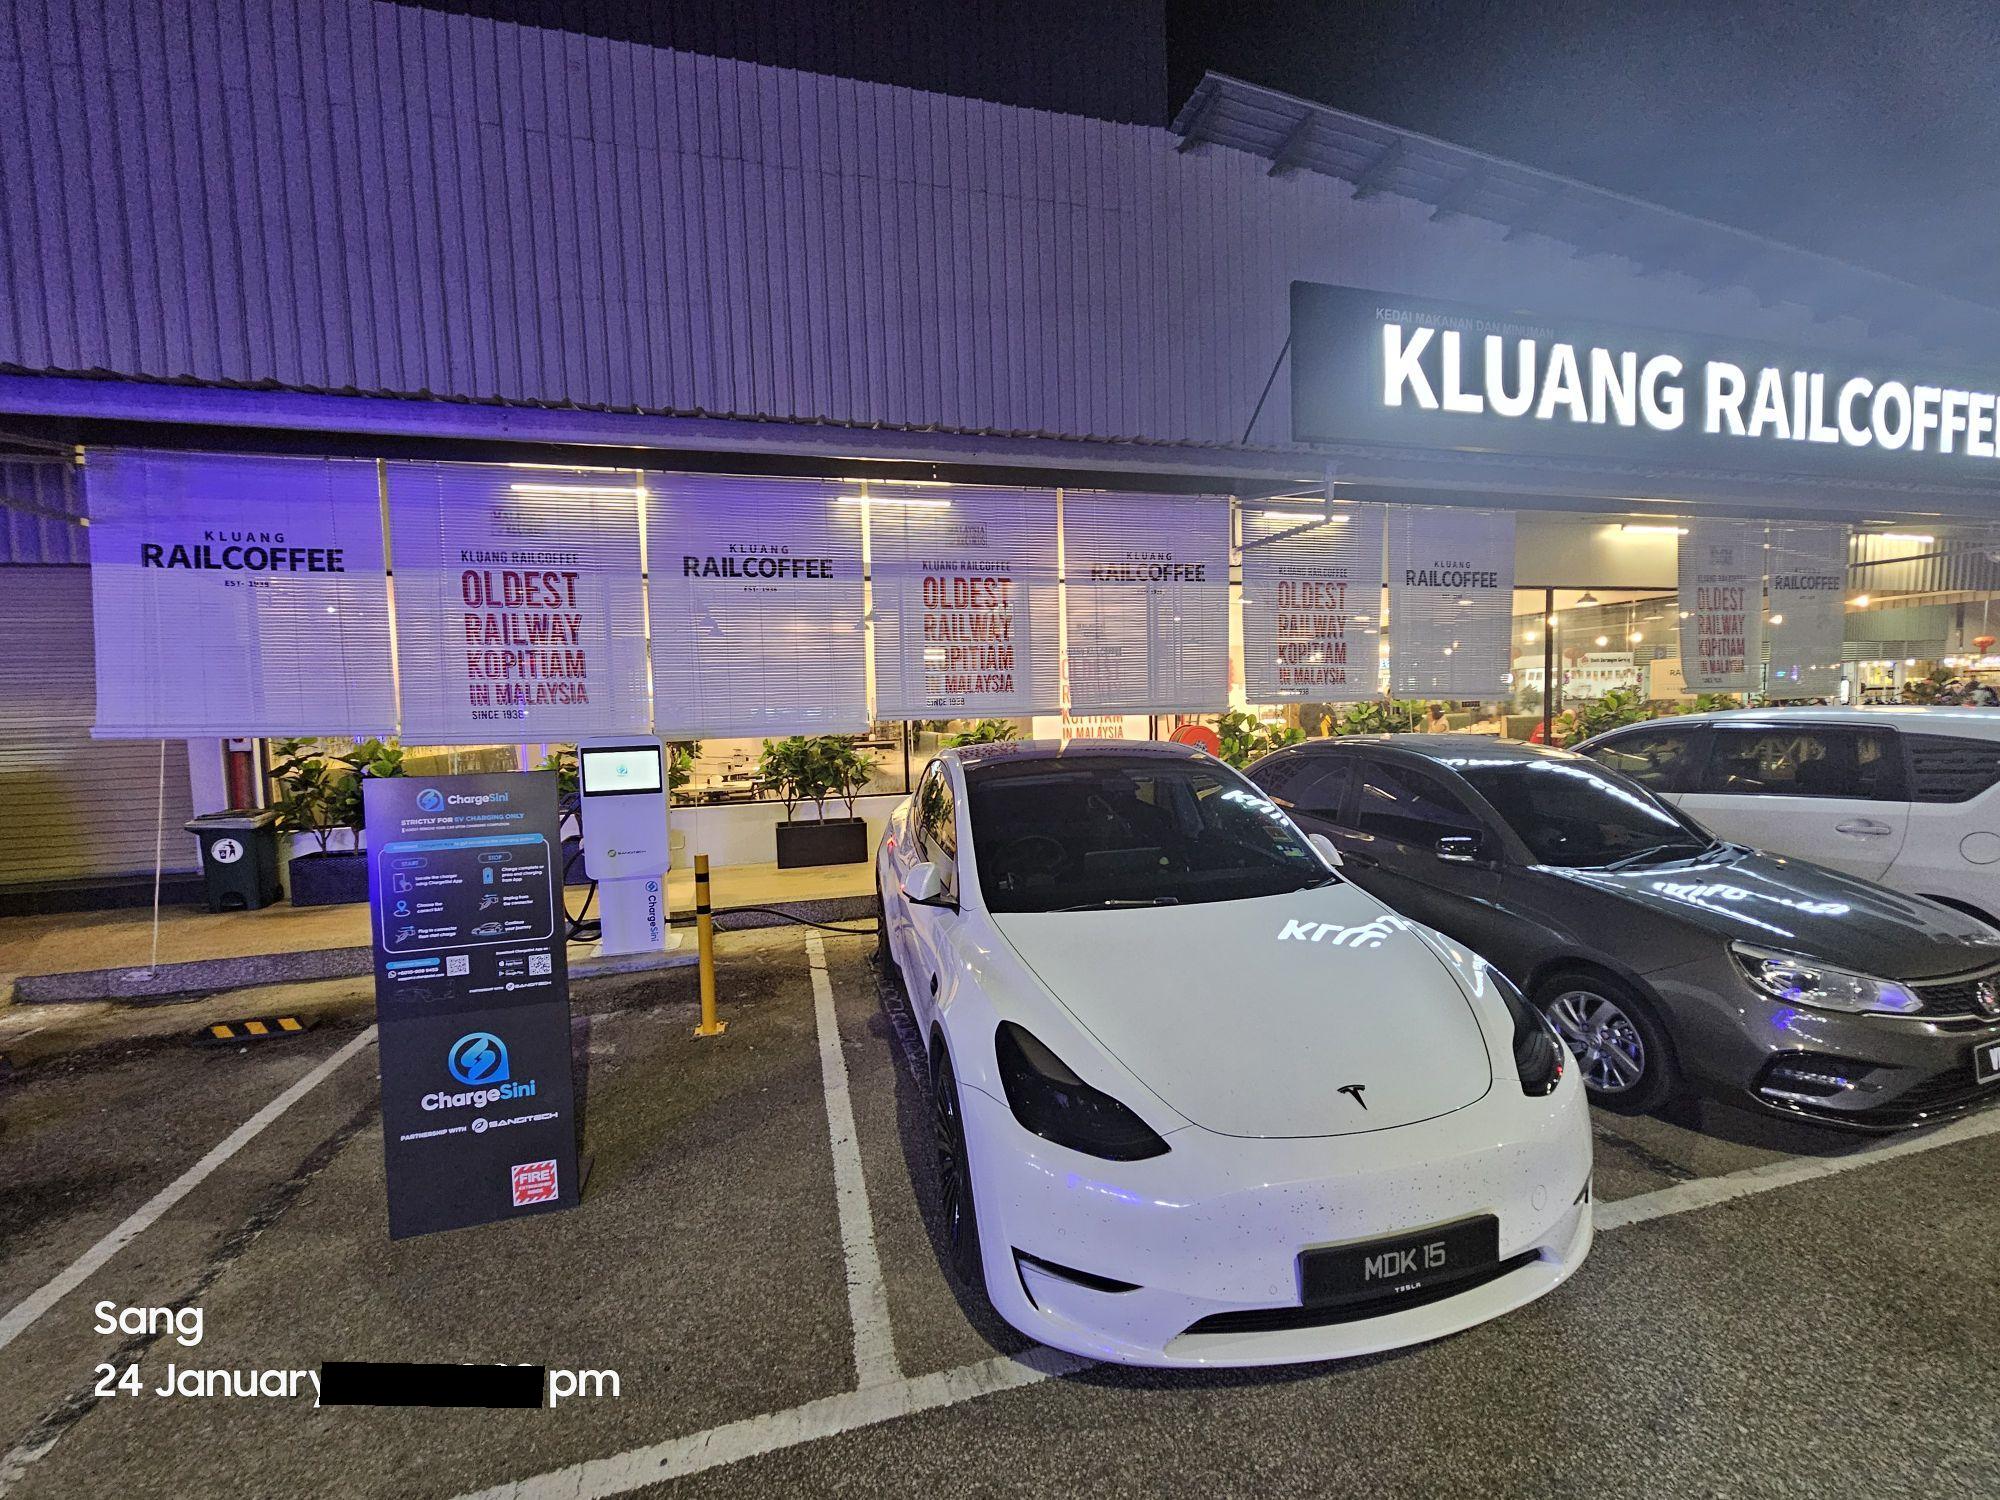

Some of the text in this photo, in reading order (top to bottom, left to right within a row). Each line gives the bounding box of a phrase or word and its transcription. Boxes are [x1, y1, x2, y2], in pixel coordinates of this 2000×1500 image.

[1375, 308, 1555, 340] KEDAI MAKANAN DAN MINUMAN
[1381, 322, 2000, 458] KLUANG RAILCOFFE
[204, 530, 285, 543] KLUANG
[141, 543, 345, 573] RAILCOFFEE
[461, 550, 579, 564] KLUANG RAILCOFFEE
[728, 544, 790, 555] KLUANG
[1126, 552, 1173, 561] KLUANG
[682, 556, 834, 579] RAILCOFFEE
[922, 560, 1011, 572] KLUANG RAILCOFFEE
[1434, 560, 1472, 569] KLUANG
[461, 569, 580, 609] OLDEST
[1405, 569, 1498, 589] RAILCOFFEE
[1774, 575, 1841, 591] RAILCOFFEE
[923, 576, 1012, 610] OLDEST
[1278, 581, 1348, 611] OLDEST
[1697, 587, 1745, 611] OLDEST
[464, 613, 583, 646] RAILWAY
[924, 613, 1014, 642] RAILWAY
[1278, 614, 1347, 639] RAILWAY
[1698, 614, 1746, 635] RAILWAY
[1698, 638, 1746, 657] KOPITIAM
[466, 650, 587, 679] KOPITIAM
[924, 645, 1014, 671] OPITIAM
[944, 674, 1015, 694] MALAYSIA
[1294, 668, 1347, 685] MALAYSIA
[469, 682, 590, 706] IN MALAYSIA
[472, 709, 525, 720] SINCE 1938
[1062, 726, 1124, 740] IN MALAYSIA
[447, 792, 509, 806] ChargeSini
[401, 817, 435, 827] STRICTLY
[437, 816, 454, 824] FOR
[466, 814, 504, 823] CHARGING
[505, 812, 525, 821] ONLY
[647, 895, 659, 942] ChargeSini
[421, 1079, 537, 1111] ChargeSini
[400, 1128, 448, 1142] PARTNERSHIP
[448, 1126, 467, 1135] WITH
[519, 1170, 551, 1185] FIRE
[1365, 1241, 1446, 1281] MDK 15
[1394, 1282, 1421, 1294] TESLA
